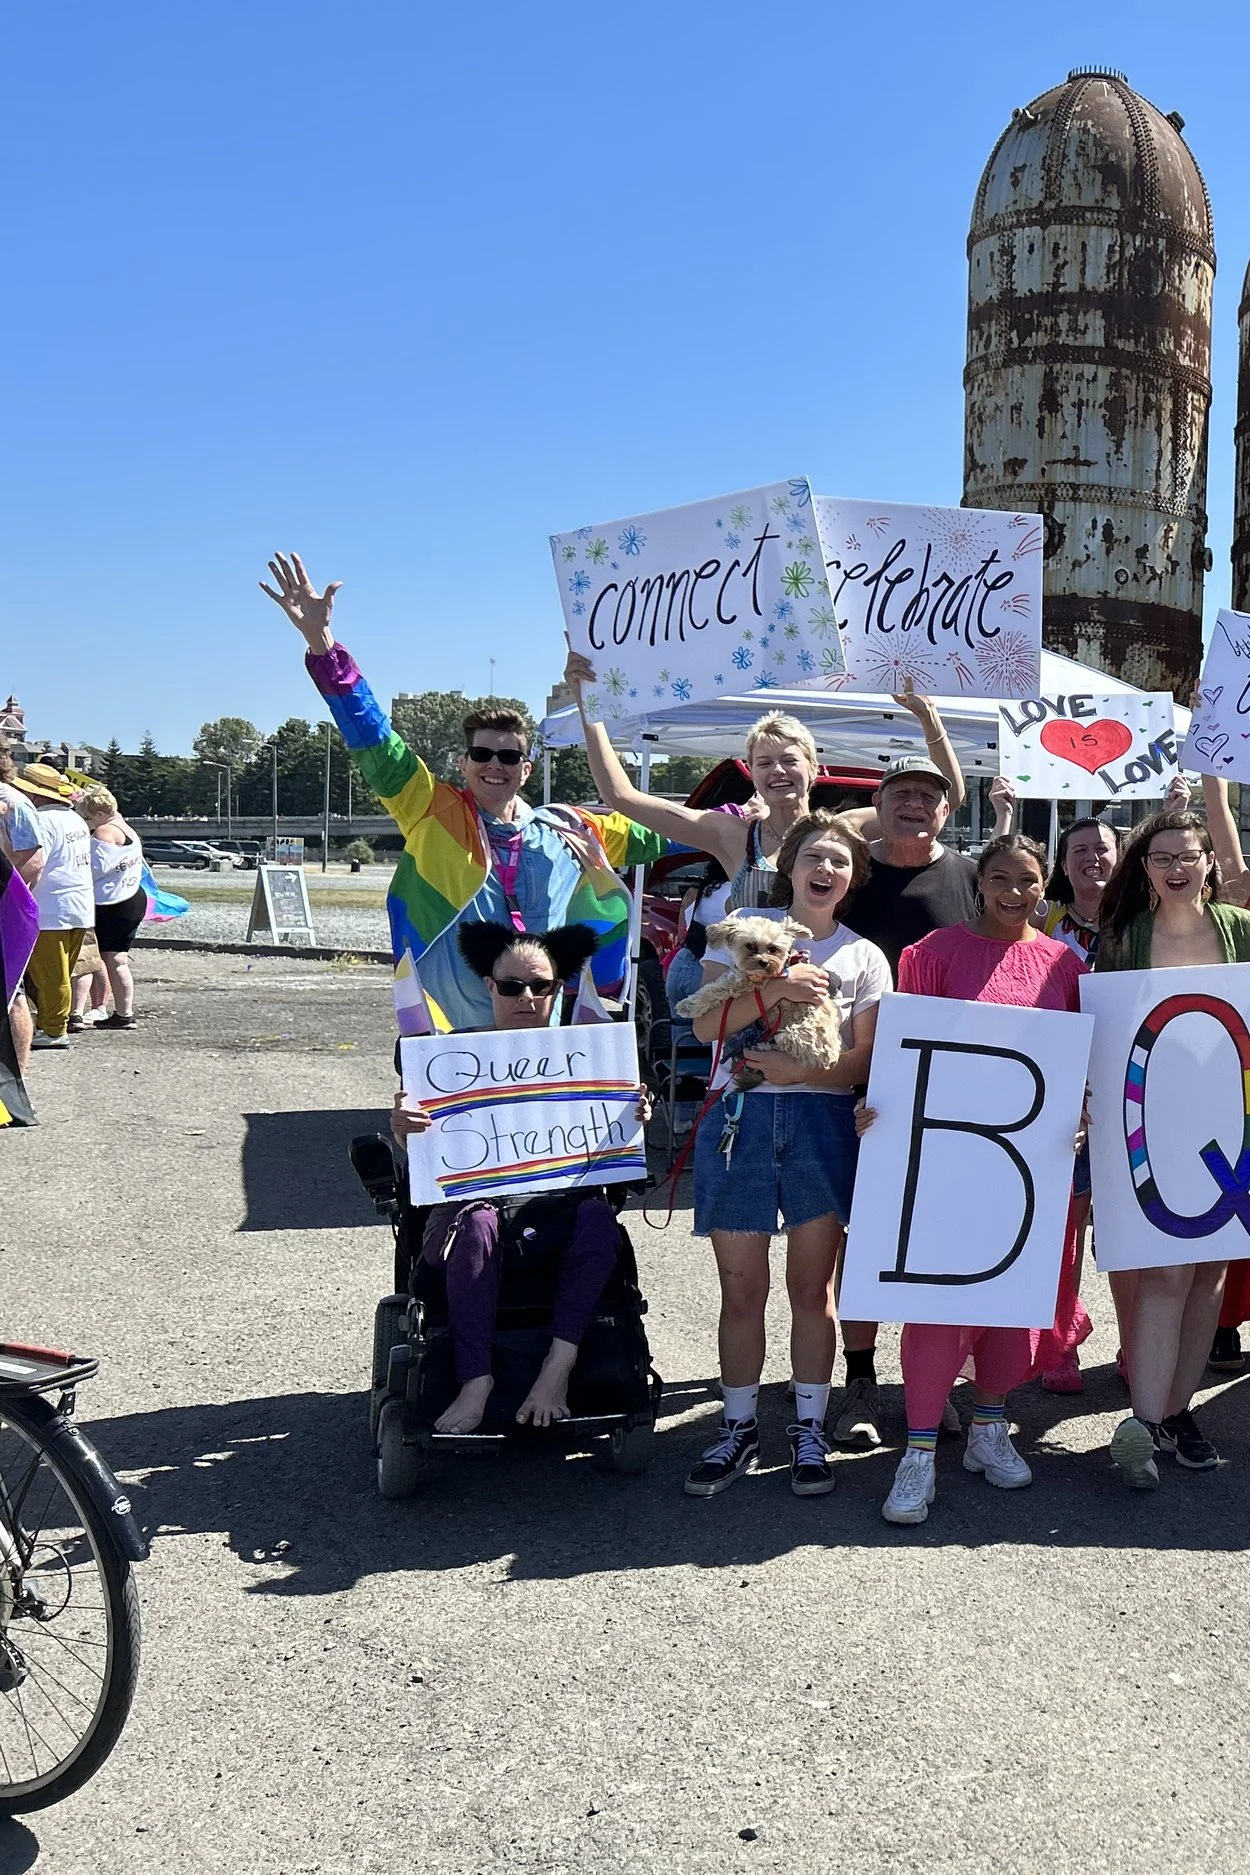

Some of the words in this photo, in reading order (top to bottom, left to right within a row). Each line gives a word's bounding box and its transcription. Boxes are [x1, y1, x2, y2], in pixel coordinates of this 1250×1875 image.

[588, 522, 780, 650] connect
[998, 694, 1098, 738] LOVE
[1069, 733, 1098, 749] IS
[1097, 728, 1178, 796] LOVE
[425, 1050, 587, 1094] Queer
[440, 1101, 627, 1180] Strength
[878, 1037, 1046, 1286] B
